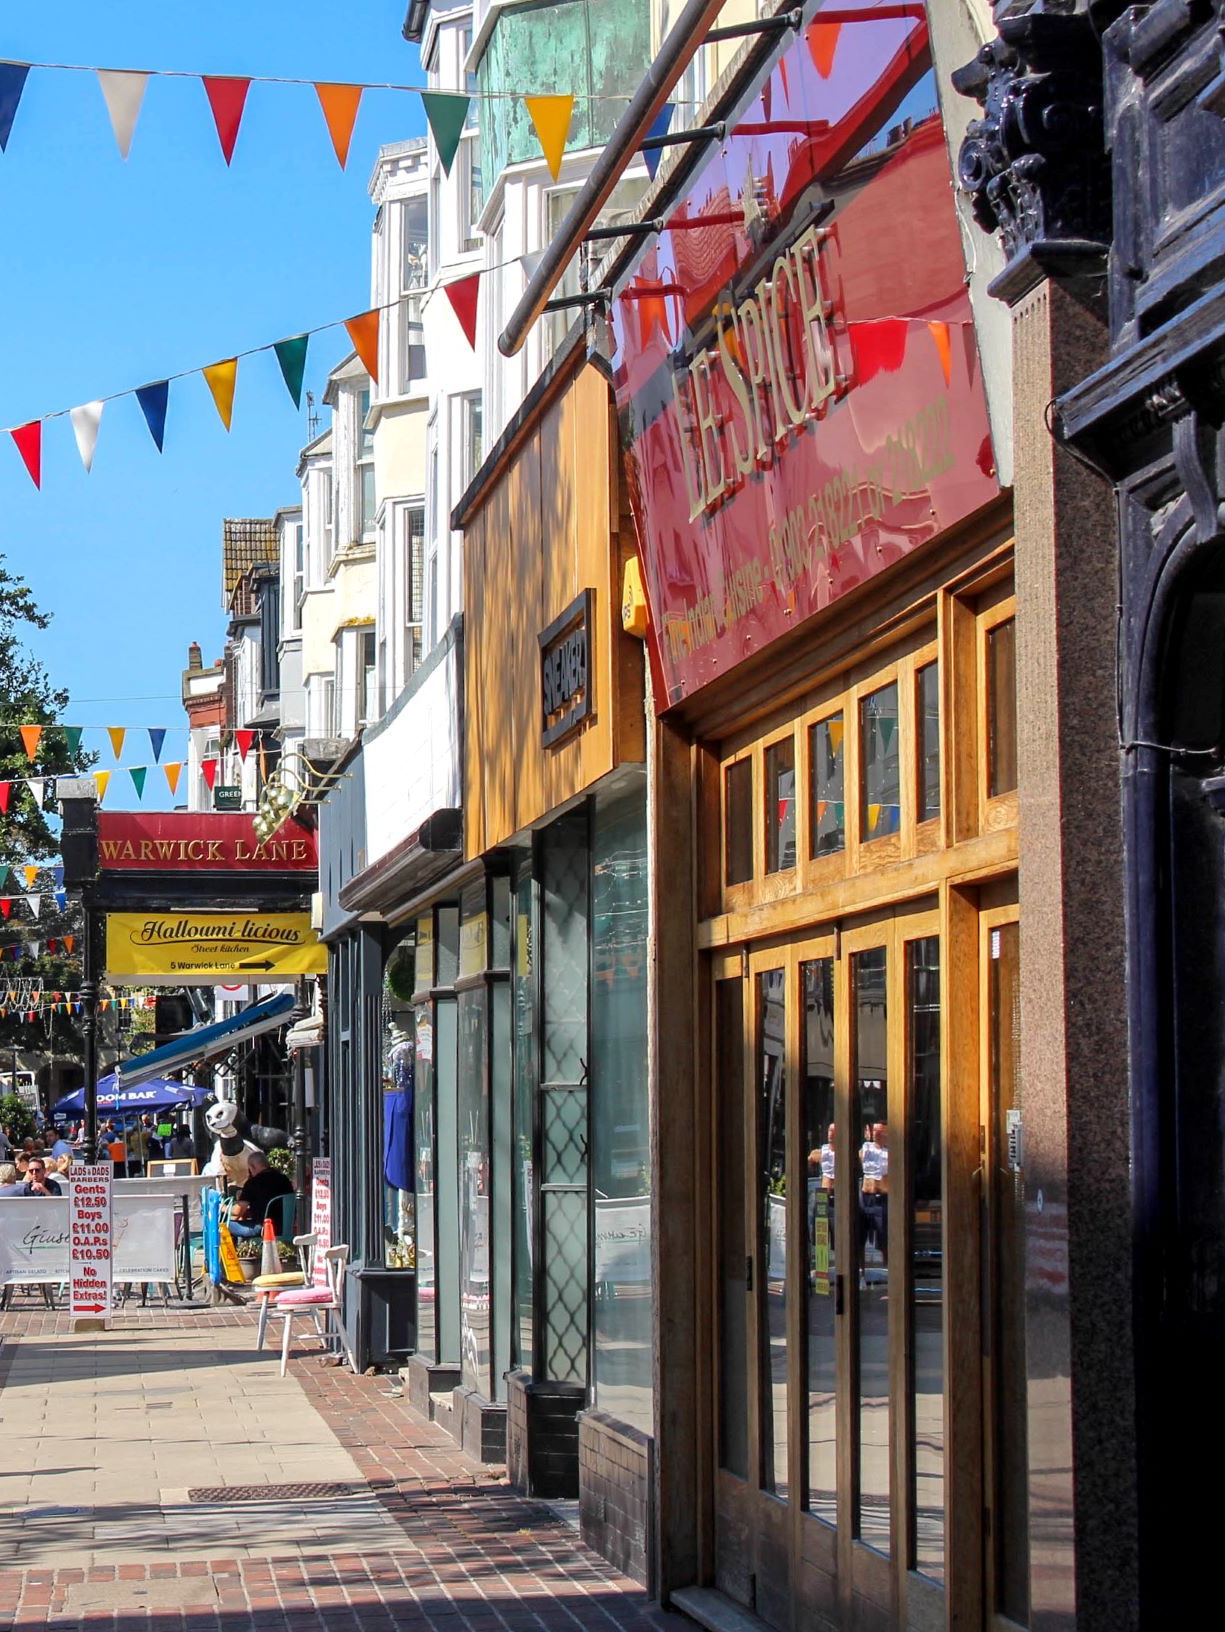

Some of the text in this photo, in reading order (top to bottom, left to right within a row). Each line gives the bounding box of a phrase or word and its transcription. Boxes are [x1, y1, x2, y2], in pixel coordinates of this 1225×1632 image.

[671, 224, 837, 525] LE SPICE
[101, 838, 308, 861] WARWICK LANE
[138, 919, 302, 943] Halloumi-licious
[191, 944, 249, 953] Street kitchen
[170, 961, 236, 970] 5 Warwick Lane
[96, 1090, 155, 1103] OOM BAR
[70, 1167, 87, 1176] LADS
[92, 1167, 110, 1176] DADS
[74, 1184, 106, 1195] Gents
[73, 1196, 108, 1208] £12.50
[77, 1209, 103, 1222] Boys
[72, 1222, 110, 1234] £11.00
[23, 1225, 70, 1255] Giuse
[72, 1248, 110, 1260] £10.50
[83, 1266, 98, 1278] No
[73, 1278, 108, 1289] Hidden
[73, 1290, 108, 1301] Extras!
